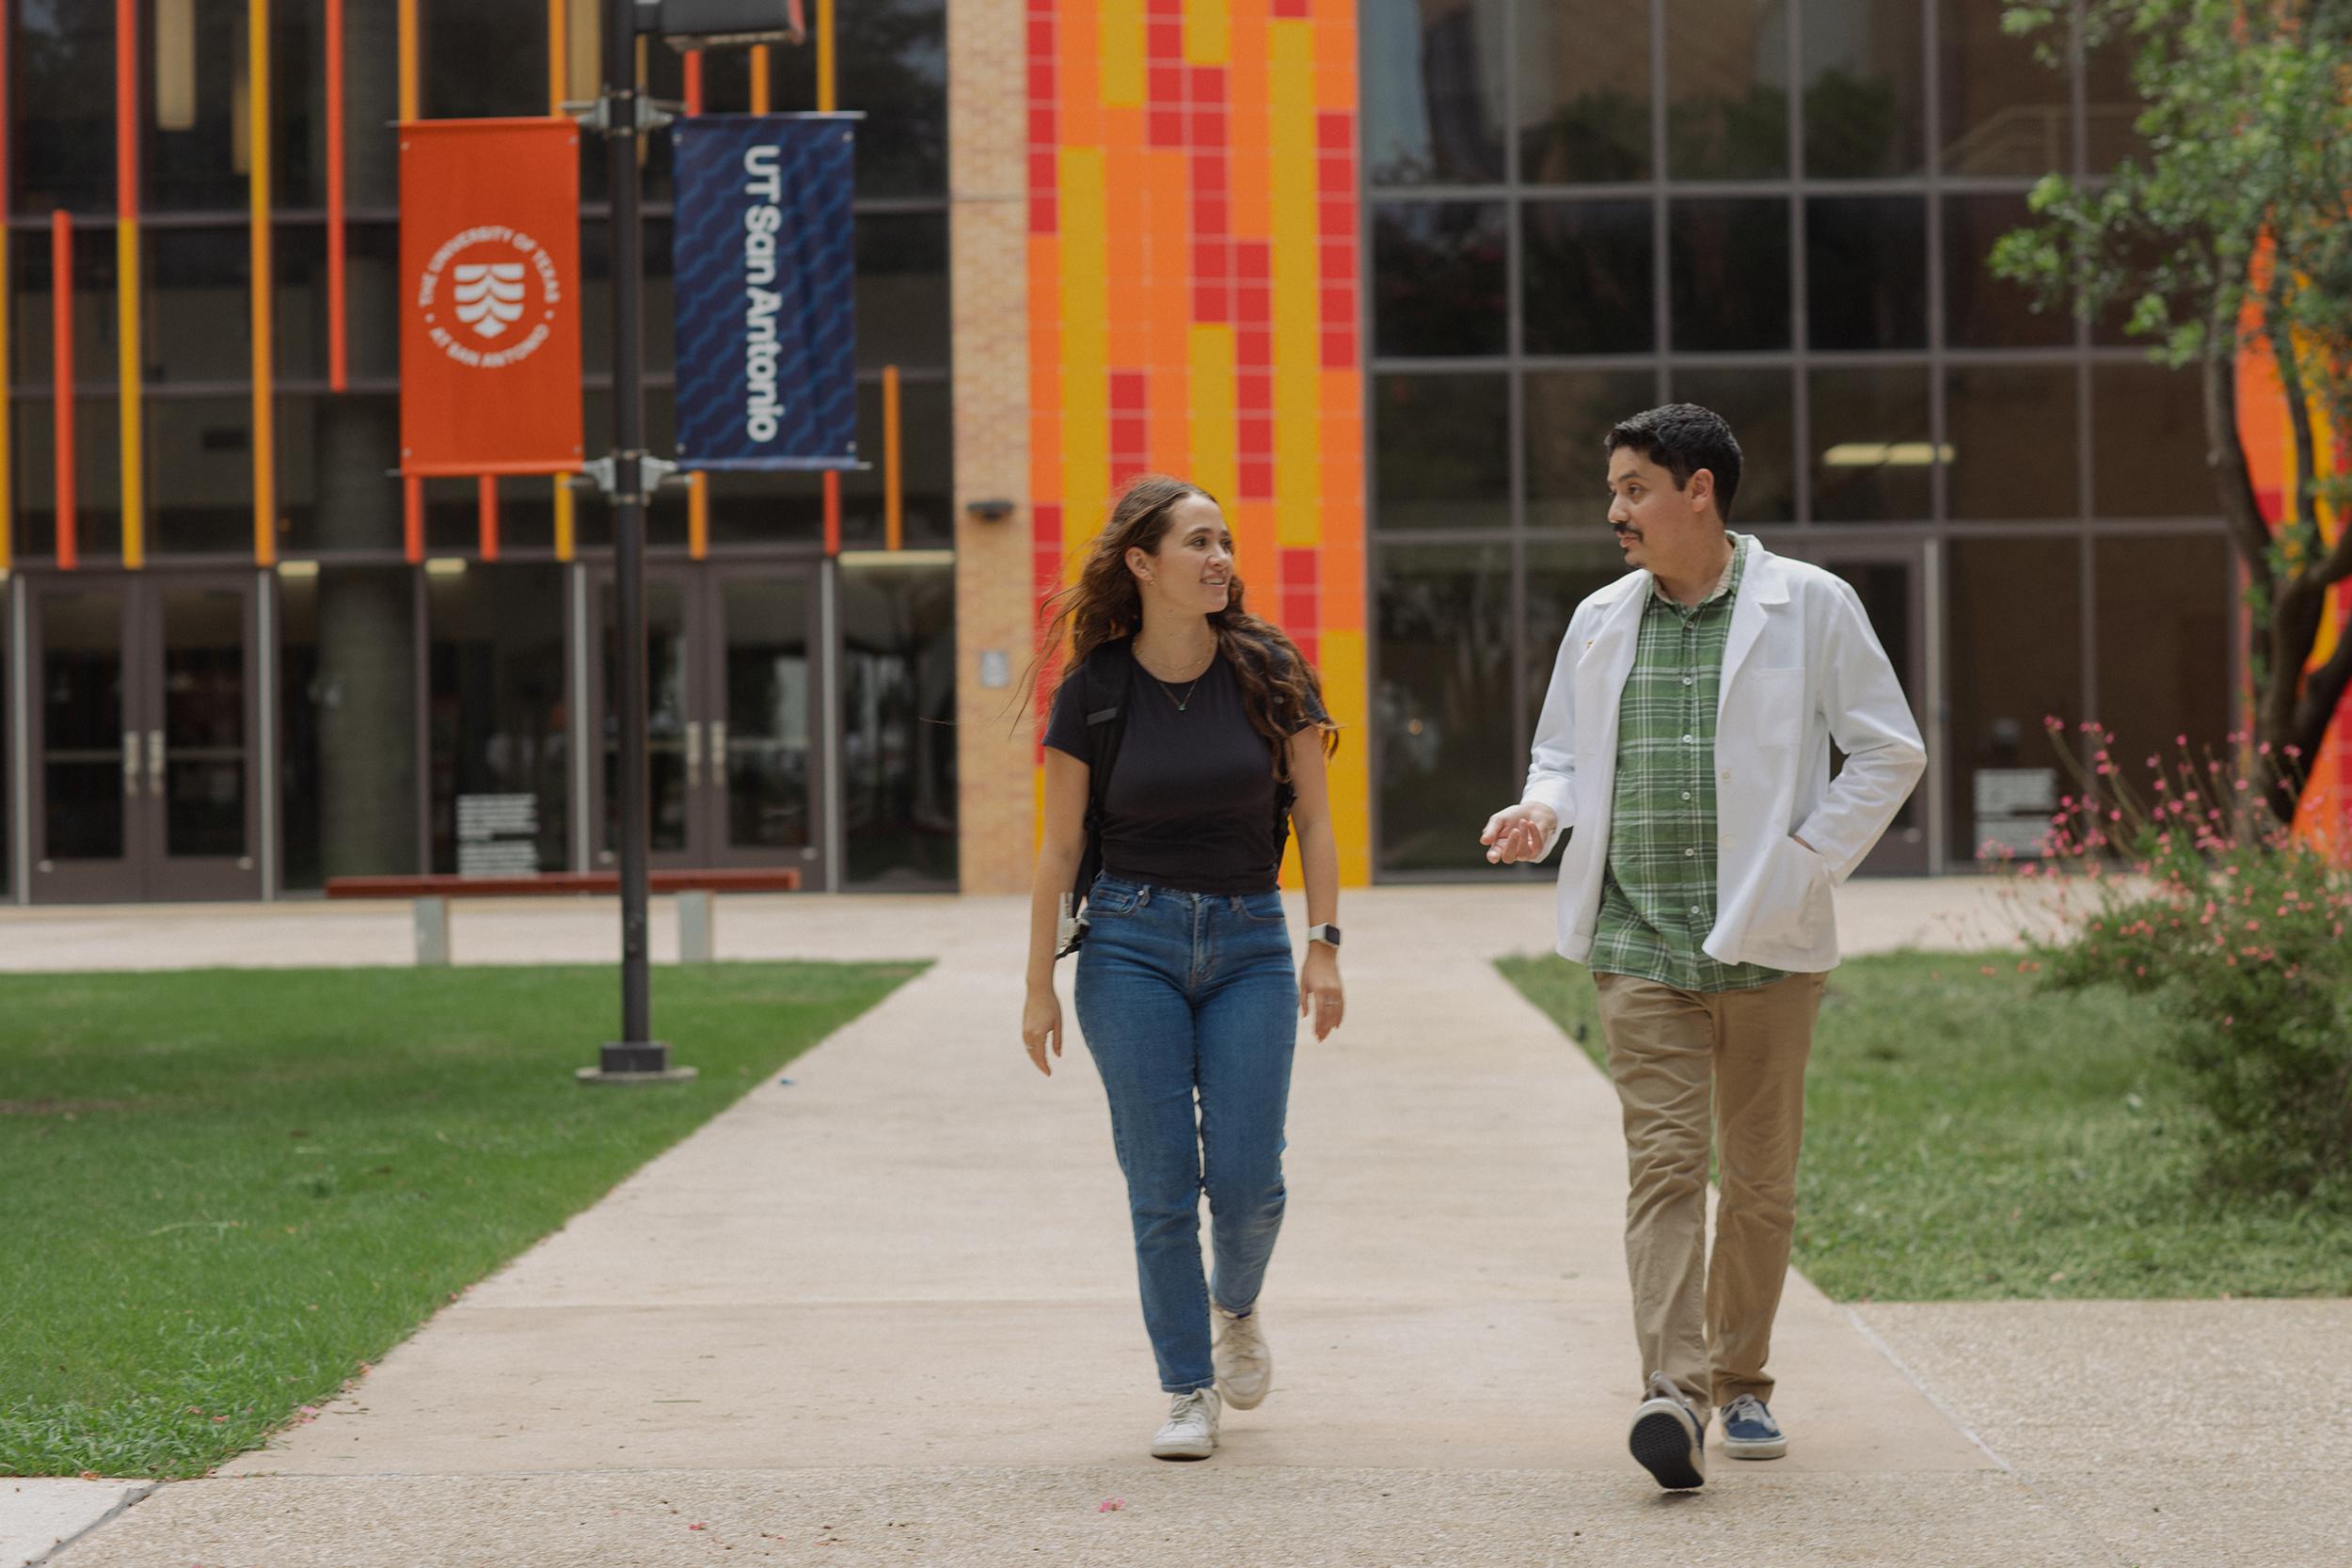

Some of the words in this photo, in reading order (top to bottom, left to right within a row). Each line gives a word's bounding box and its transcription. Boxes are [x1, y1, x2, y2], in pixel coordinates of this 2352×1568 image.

[744, 145, 780, 203] UT
[512, 232, 537, 252] OF
[532, 248, 561, 303] TEXAS
[744, 205, 781, 284] San
[746, 286, 785, 442] Antonio
